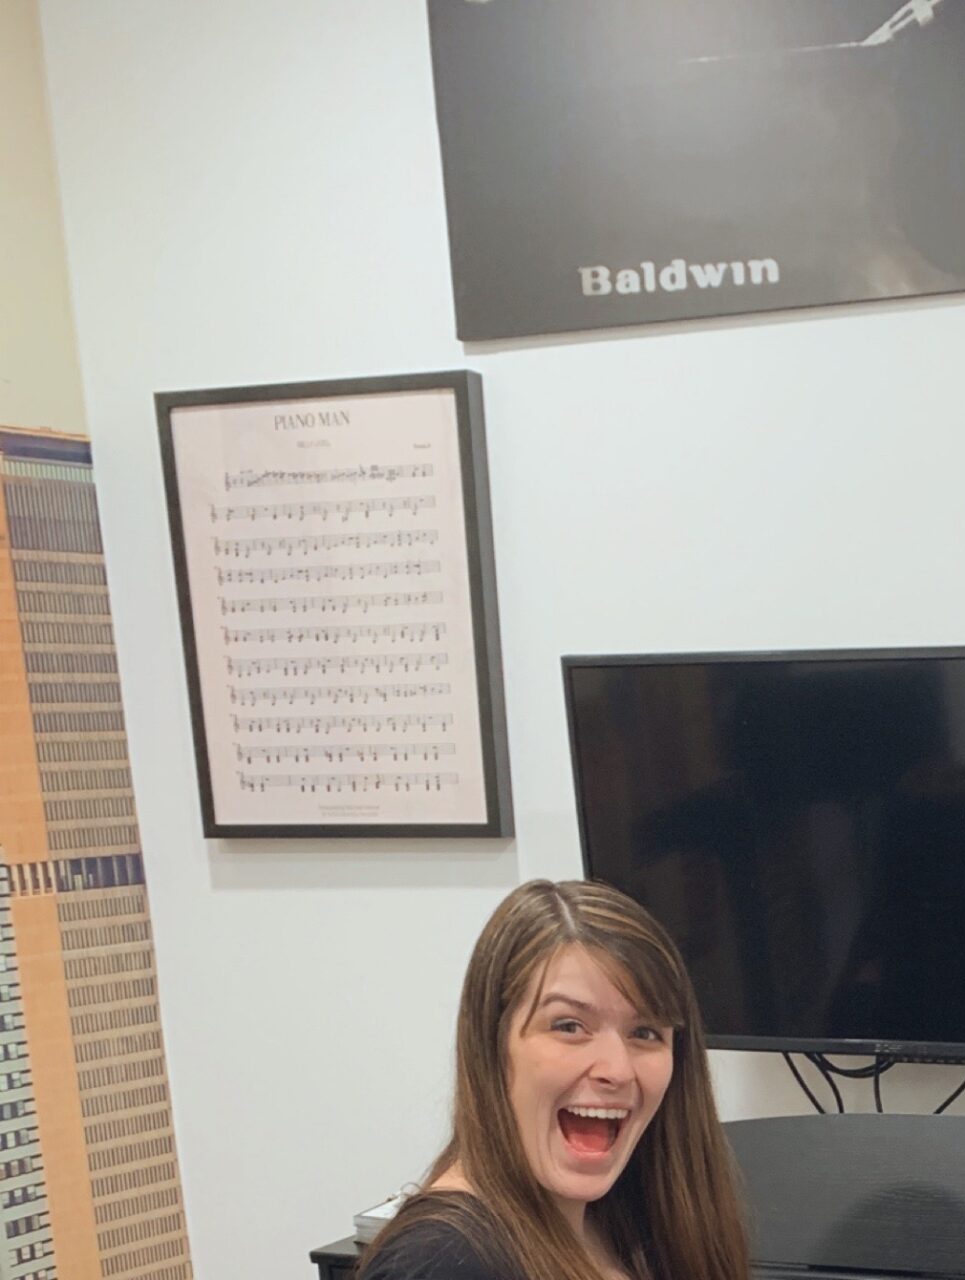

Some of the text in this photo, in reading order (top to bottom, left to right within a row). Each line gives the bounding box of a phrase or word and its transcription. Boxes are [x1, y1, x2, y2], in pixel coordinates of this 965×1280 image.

[577, 258, 780, 296] Baldwin
[274, 409, 351, 431] PIANO MAN
